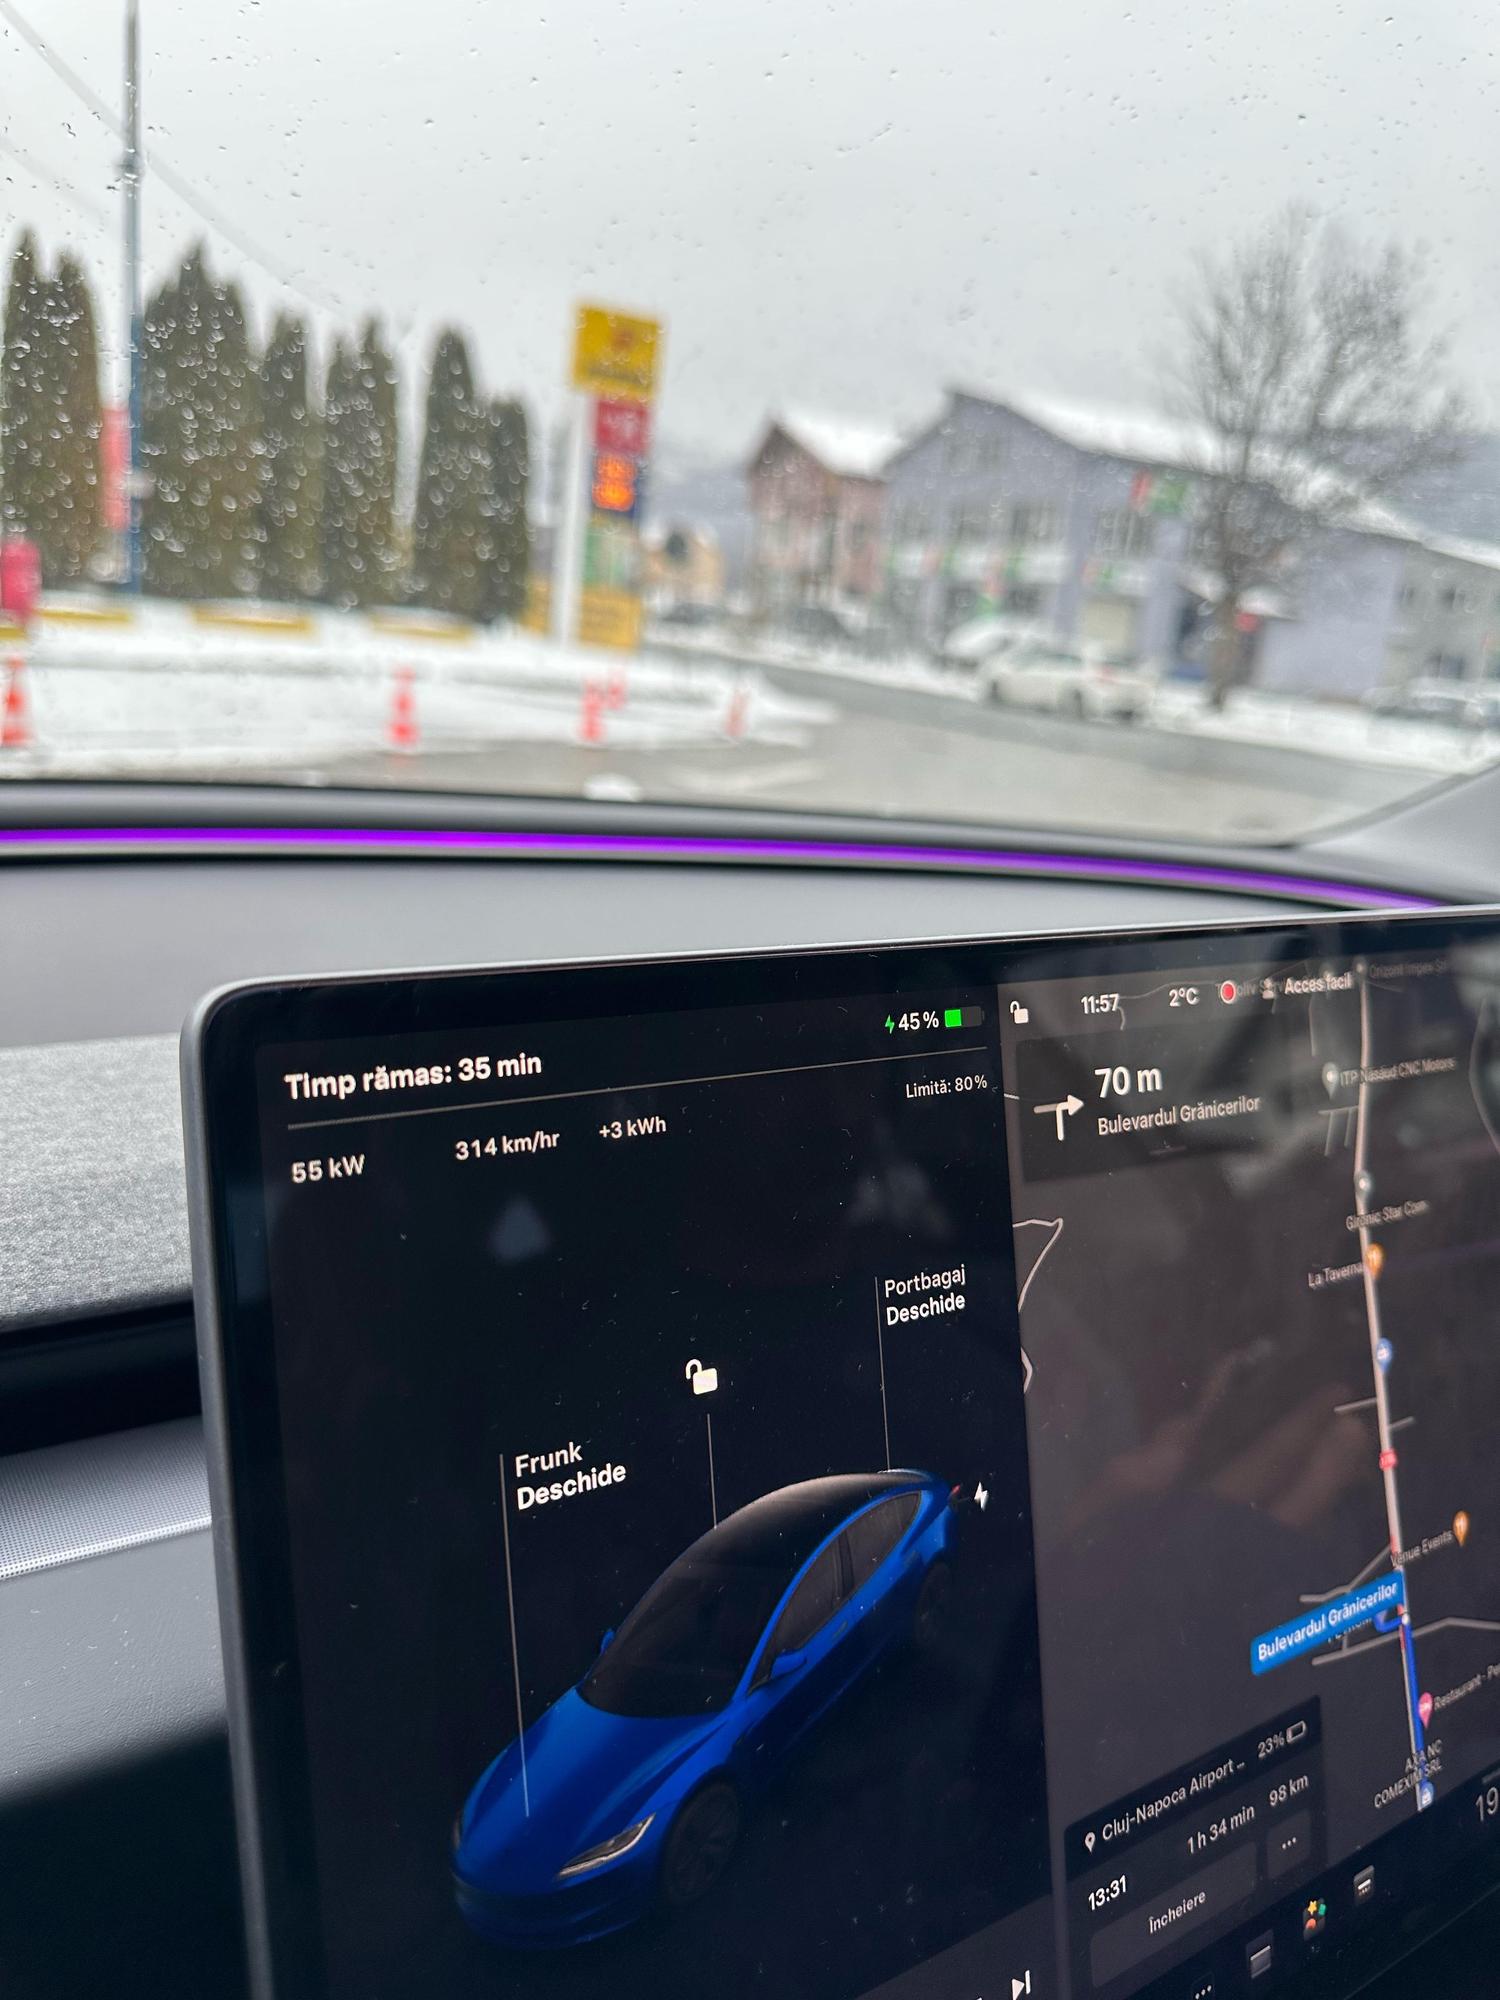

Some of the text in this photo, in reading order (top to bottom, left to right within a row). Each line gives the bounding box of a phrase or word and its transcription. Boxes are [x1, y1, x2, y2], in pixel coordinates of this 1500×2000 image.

[1169, 987, 1200, 1007] 2°C
[1284, 976, 1324, 994] Acces
[1325, 970, 1352, 991] facil
[1081, 993, 1120, 1014] 11:57
[284, 1052, 542, 1100] Timp rămas: 35 min
[905, 1079, 952, 1099] Limită:
[1094, 1066, 1163, 1098] 70 m
[599, 1116, 667, 1139] +3 kWh
[1098, 1095, 1261, 1136] Bulevardul Grănicerilor
[455, 1130, 560, 1160] 314 km/hr
[291, 1154, 365, 1184] 55 kW
[884, 1263, 966, 1298] Portbagaj
[886, 1292, 966, 1326] Deschide
[515, 1441, 583, 1478] Frunk
[517, 1462, 627, 1511] Deschide
[1421, 1529, 1454, 1553] Events
[1257, 1613, 1326, 1662] Bulevardul
[1328, 1581, 1399, 1627] Grănicerilor
[1257, 1732, 1286, 1759] 23%
[1102, 1787, 1187, 1841] Cluj-Napoca
[1189, 1758, 1234, 1795] Airport
[1268, 1774, 1310, 1808] 98 km
[1187, 1804, 1256, 1855] 1 h 34 min
[1088, 1874, 1127, 1912] 13:31
[1149, 1889, 1207, 1935] Încheiere
